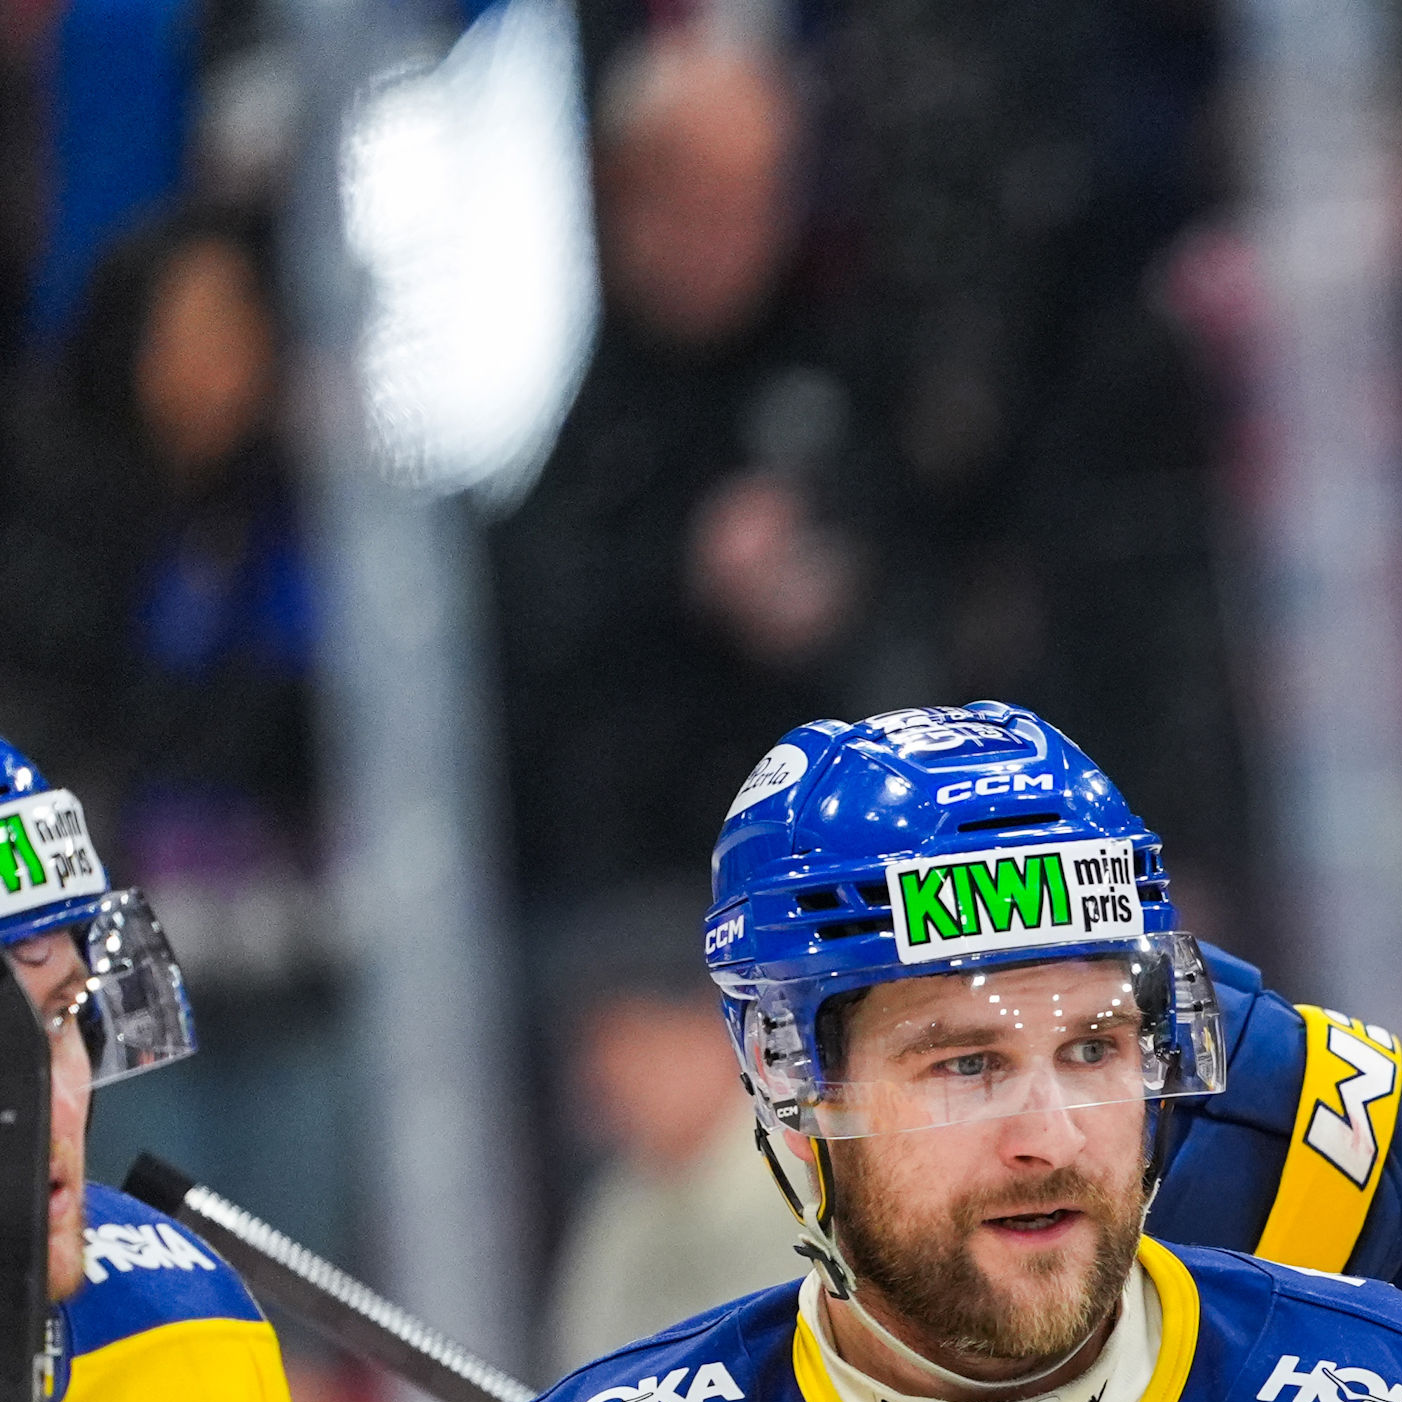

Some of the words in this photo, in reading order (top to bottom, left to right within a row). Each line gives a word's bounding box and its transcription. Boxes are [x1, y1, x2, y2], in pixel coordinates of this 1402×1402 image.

[937, 774, 1053, 804] CCM
[899, 853, 1073, 947] KIWI
[1073, 849, 1131, 885] mini
[1081, 889, 1132, 932] pris
[705, 915, 744, 954] CCM
